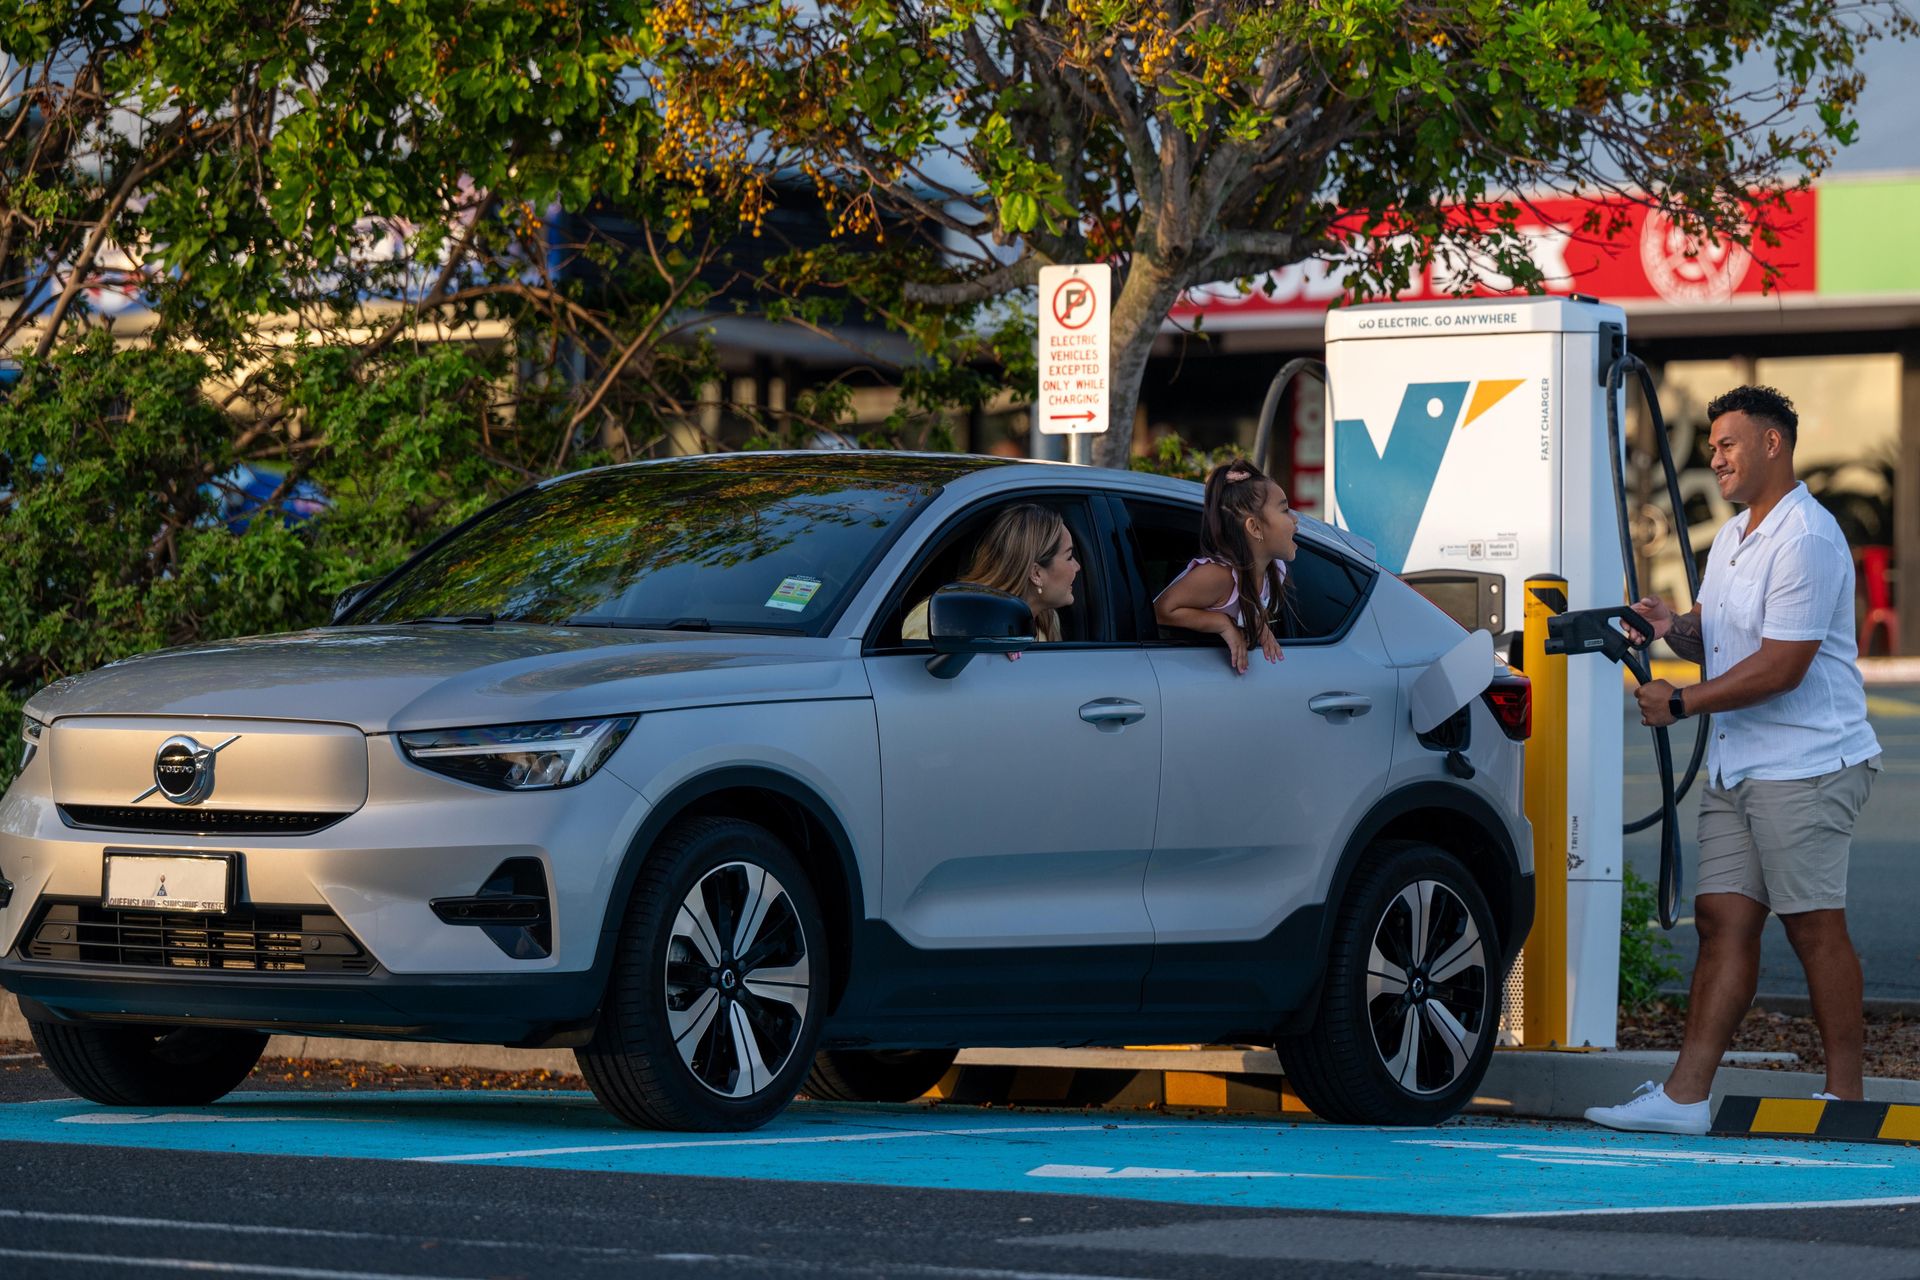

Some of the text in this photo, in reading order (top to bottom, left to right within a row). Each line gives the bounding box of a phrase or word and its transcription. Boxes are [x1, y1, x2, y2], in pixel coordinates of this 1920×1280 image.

[1358, 313, 1517, 329] GO ELECTRIC. GO ANYWHERE
[1050, 334, 1097, 347] ELECTRIC
[1050, 350, 1098, 362] VEHICLES
[1049, 364, 1099, 376] EXCEPTED
[1043, 379, 1105, 391] ONLY WHILE
[1049, 394, 1100, 406] CHARGING
[1541, 378, 1549, 461] FAST CHARGER
[158, 765, 195, 774] VOLVO
[109, 897, 155, 907] QUEENSLAND
